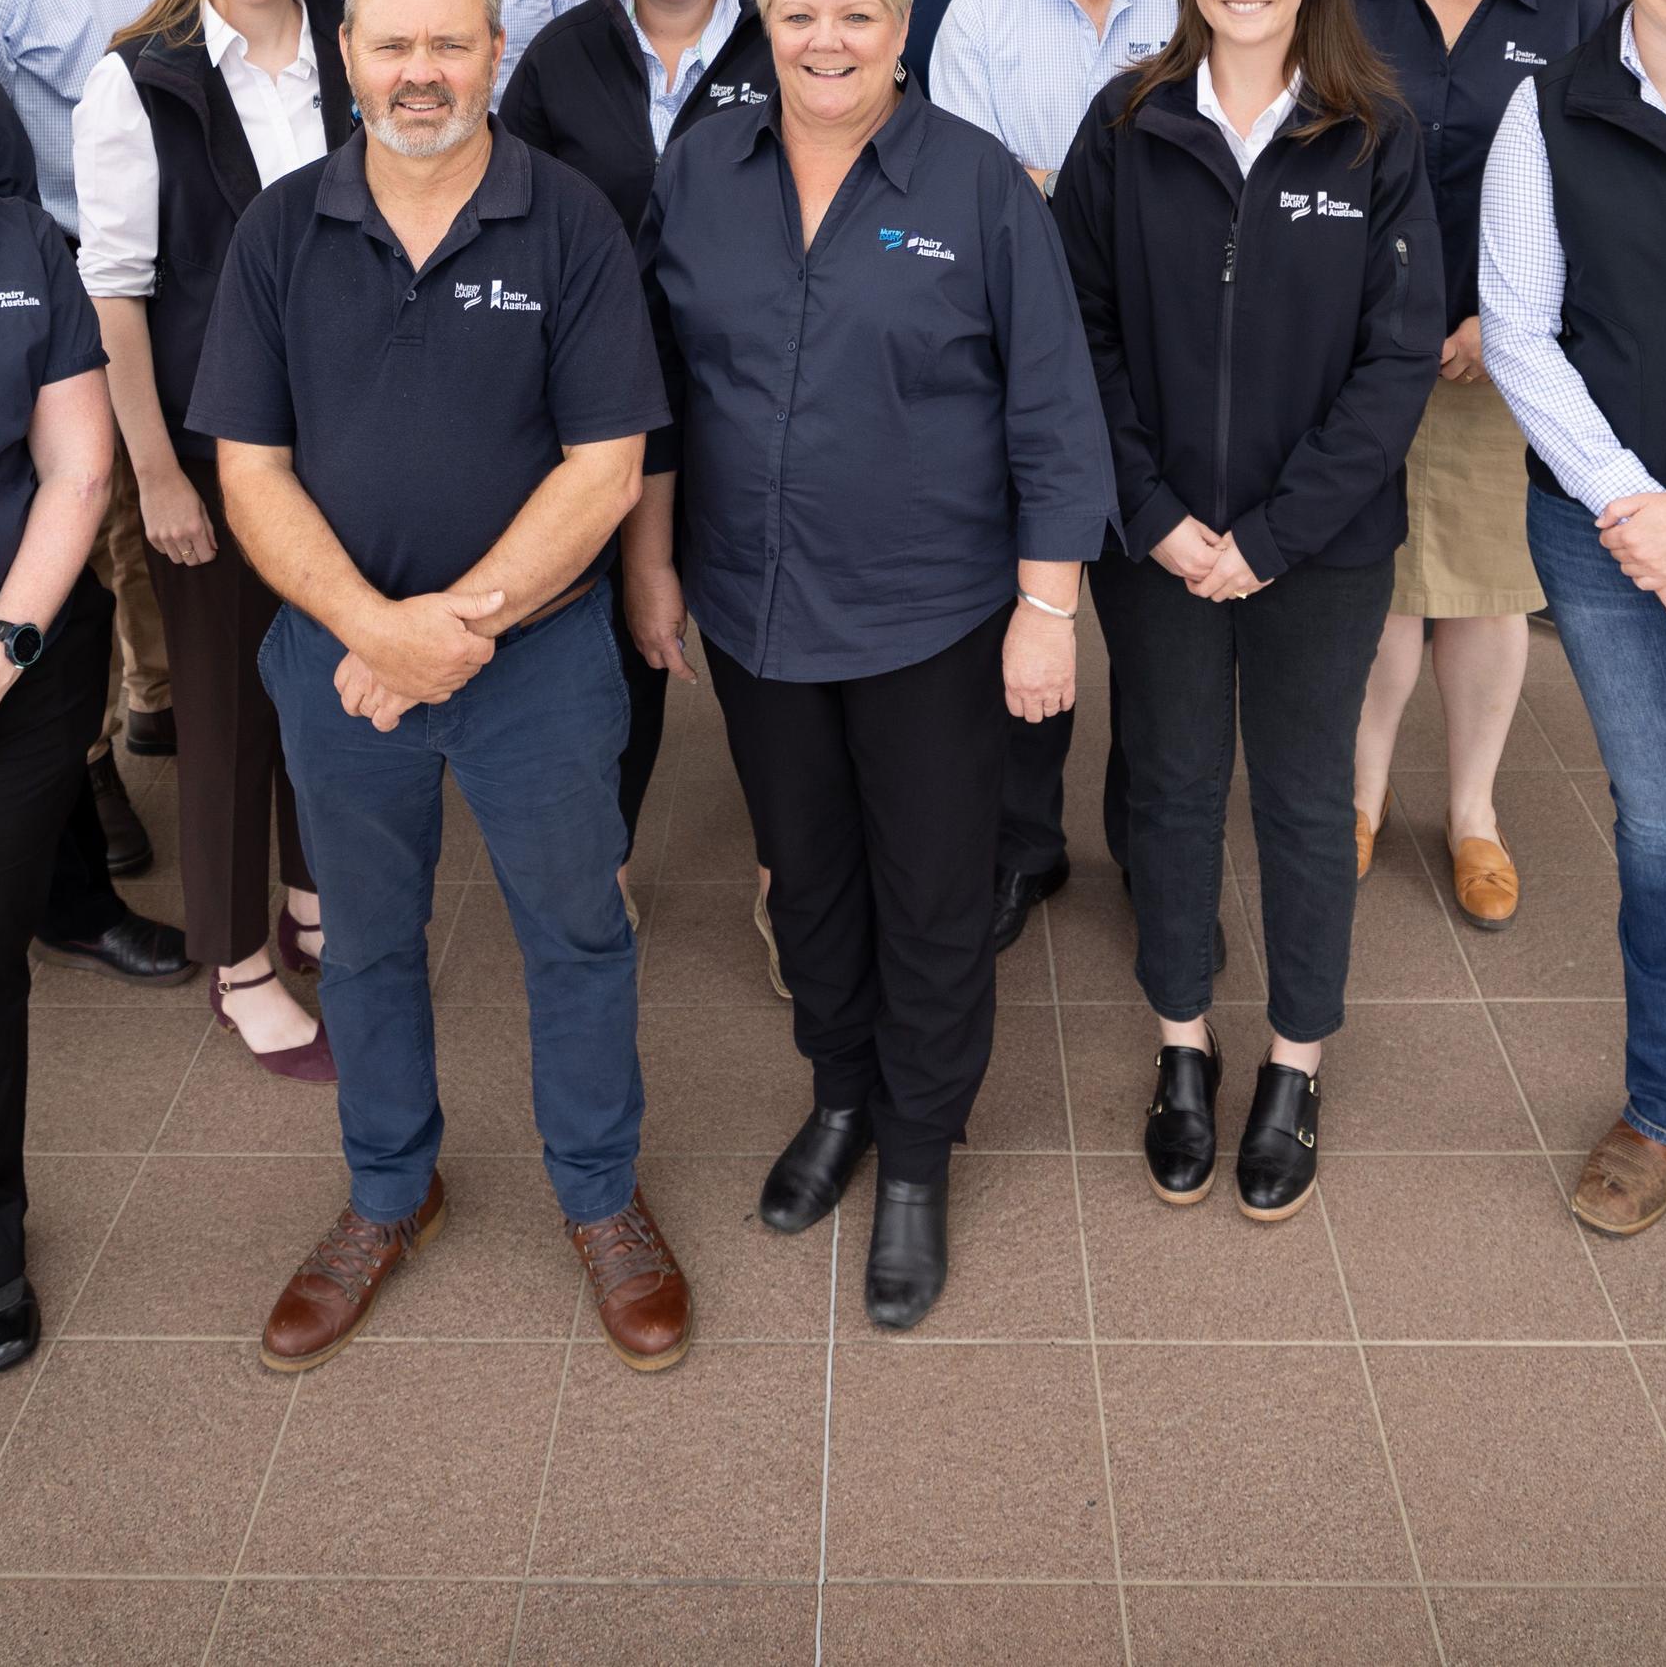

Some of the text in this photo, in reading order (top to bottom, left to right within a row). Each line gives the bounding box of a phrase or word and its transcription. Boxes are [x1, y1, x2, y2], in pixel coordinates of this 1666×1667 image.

[710, 83, 735, 93] Murray
[750, 90, 768, 101] Dairy
[1280, 191, 1309, 201] Murray
[1280, 199, 1306, 208] DAIRY
[1328, 200, 1351, 210] Dairy
[1328, 208, 1364, 218] Australia
[918, 237, 942, 250] Dairy
[917, 247, 955, 261] Australia
[455, 282, 481, 293] Murray
[454, 290, 479, 298] DAIRY
[502, 291, 528, 302] Dairy
[0, 298, 40, 308] Australia
[502, 301, 541, 311] Australia
